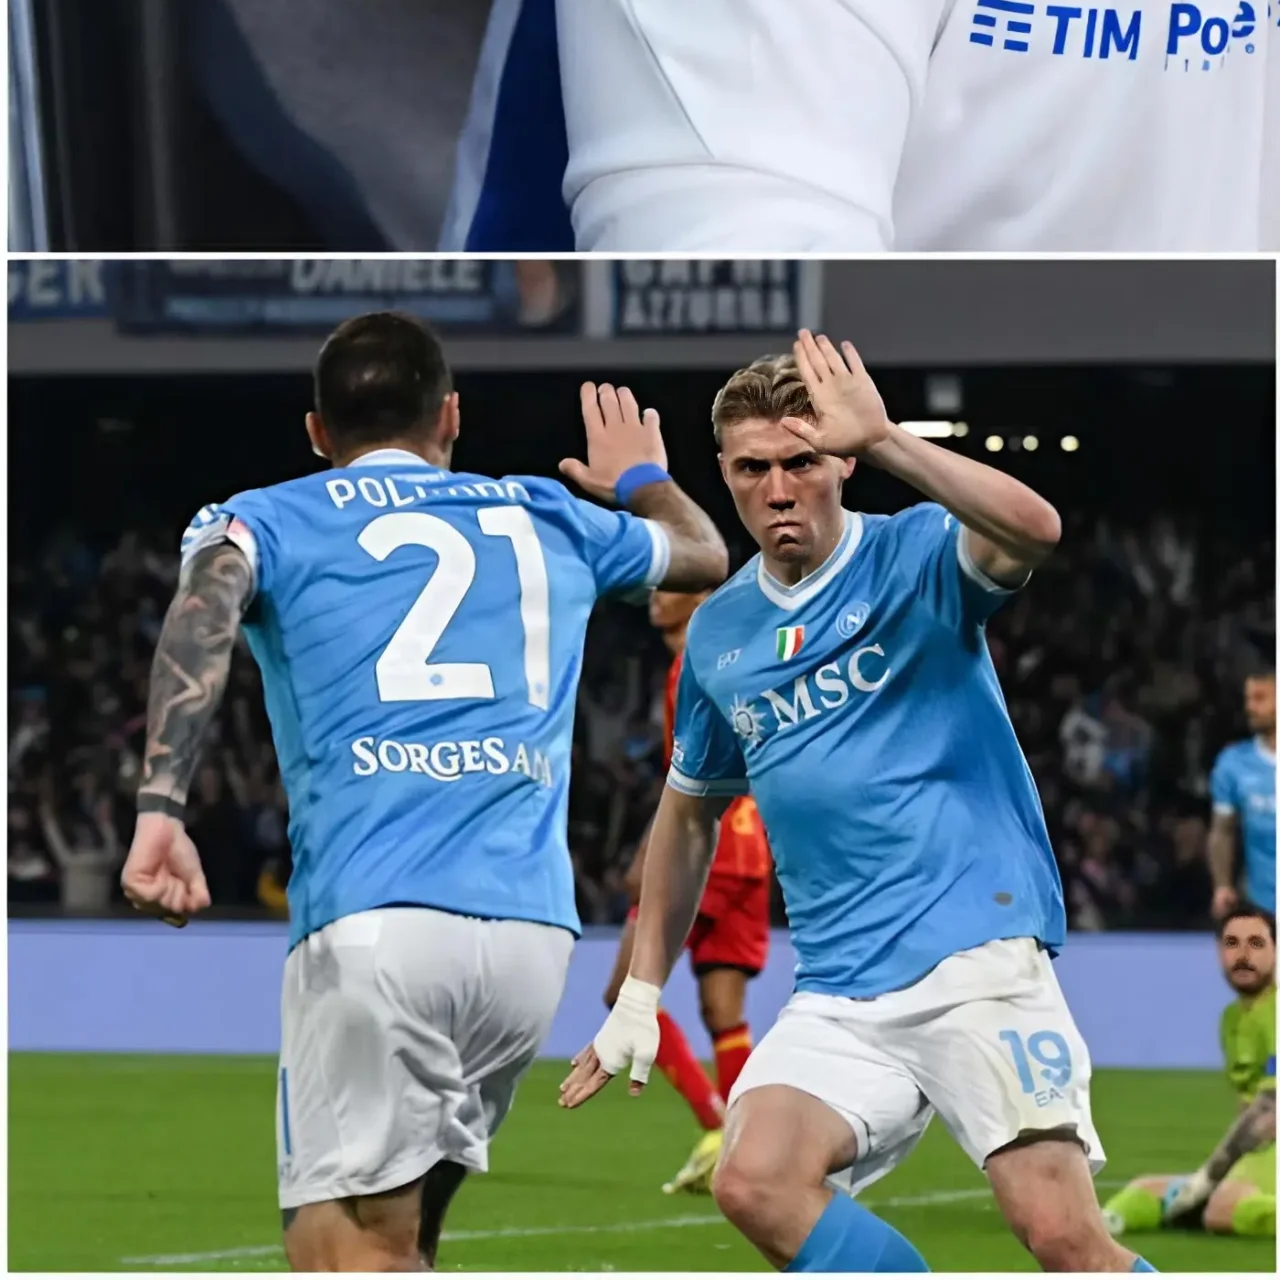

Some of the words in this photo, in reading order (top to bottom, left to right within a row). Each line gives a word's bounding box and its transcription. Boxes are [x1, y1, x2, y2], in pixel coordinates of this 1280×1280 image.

[1046, 5, 1142, 61] TIM
[356, 512, 551, 711] 21
[760, 642, 891, 732] MSC
[998, 1028, 1073, 1094] 19
